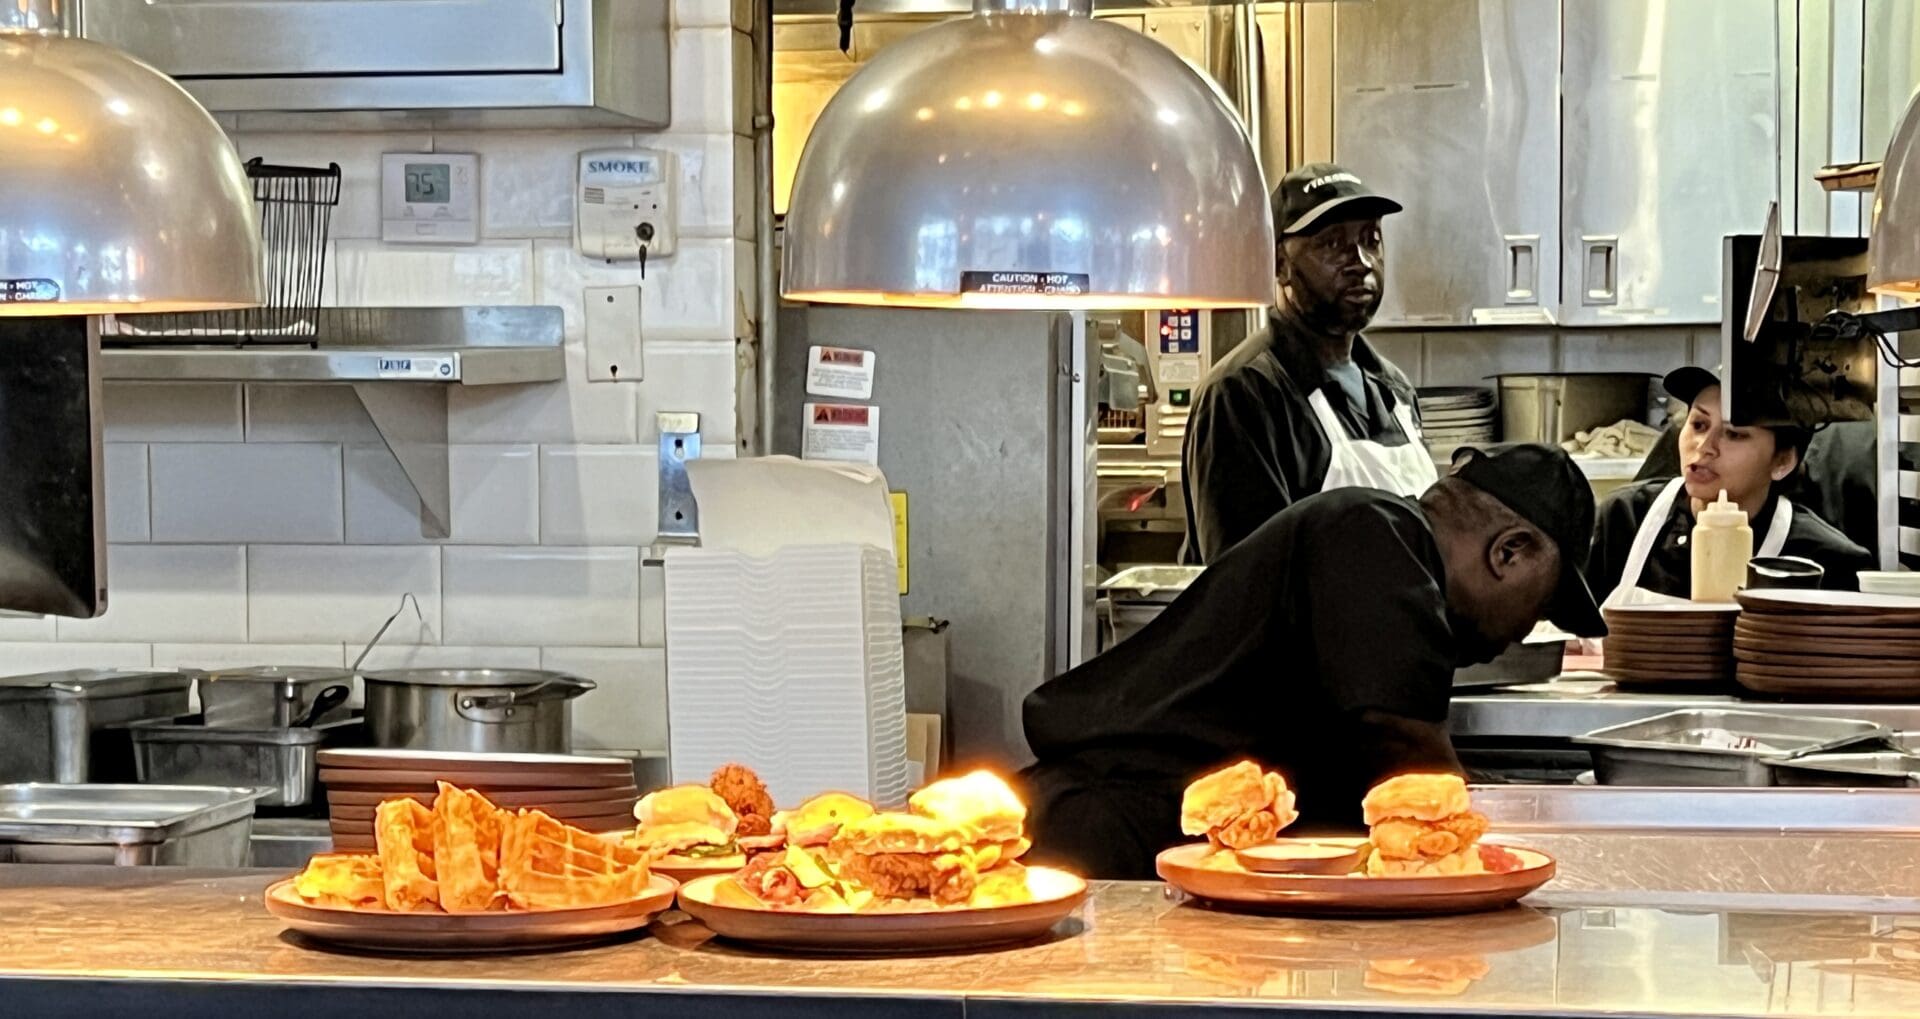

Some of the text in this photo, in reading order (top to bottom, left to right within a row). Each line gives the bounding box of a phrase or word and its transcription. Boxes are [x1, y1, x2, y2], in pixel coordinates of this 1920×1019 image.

[588, 161, 650, 174] SMOKE
[407, 172, 435, 195] 75
[992, 273, 1068, 285] CAUTION HOT
